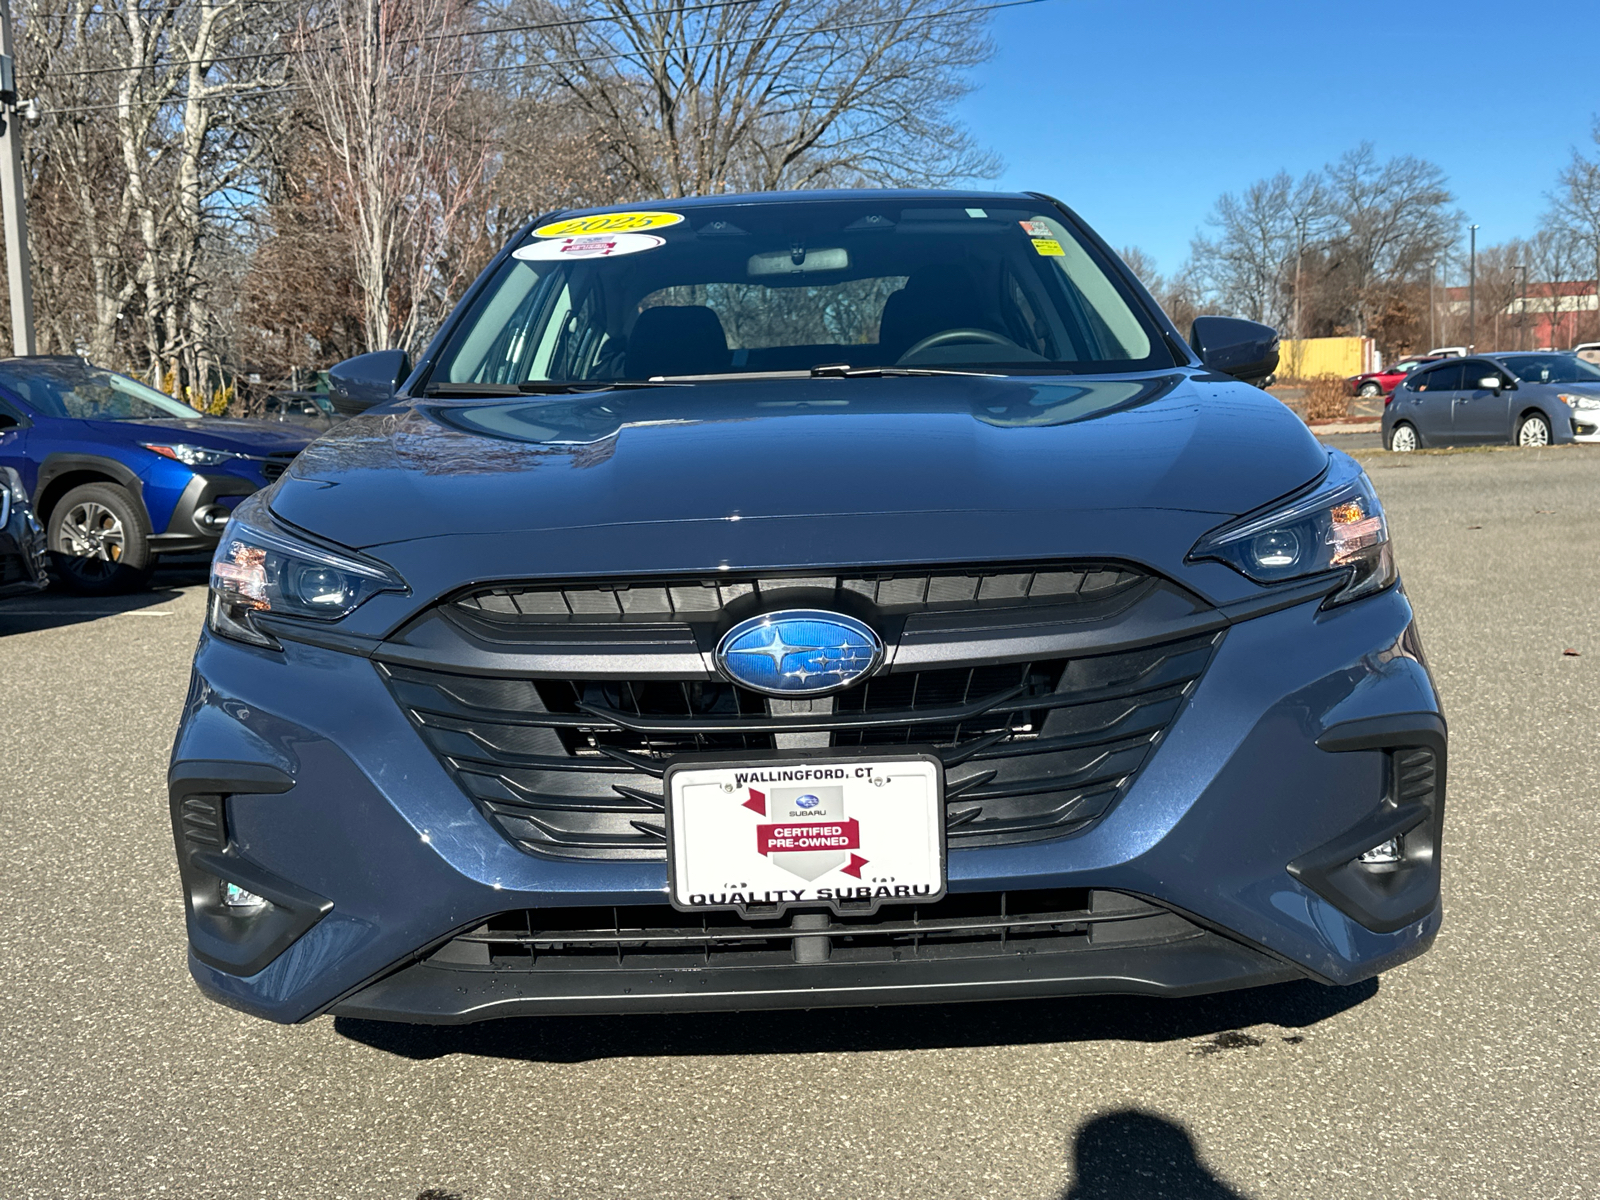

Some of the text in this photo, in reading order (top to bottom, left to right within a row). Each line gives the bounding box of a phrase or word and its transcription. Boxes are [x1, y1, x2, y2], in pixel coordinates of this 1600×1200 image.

[555, 215, 662, 234] 2025
[735, 767, 874, 783] WALLINGFORD, CT
[789, 809, 827, 817] SUBARU
[773, 826, 842, 837] CERTIFIED
[767, 836, 849, 848] PRE-OWNED
[688, 883, 931, 906] QUALITY SUBARU
